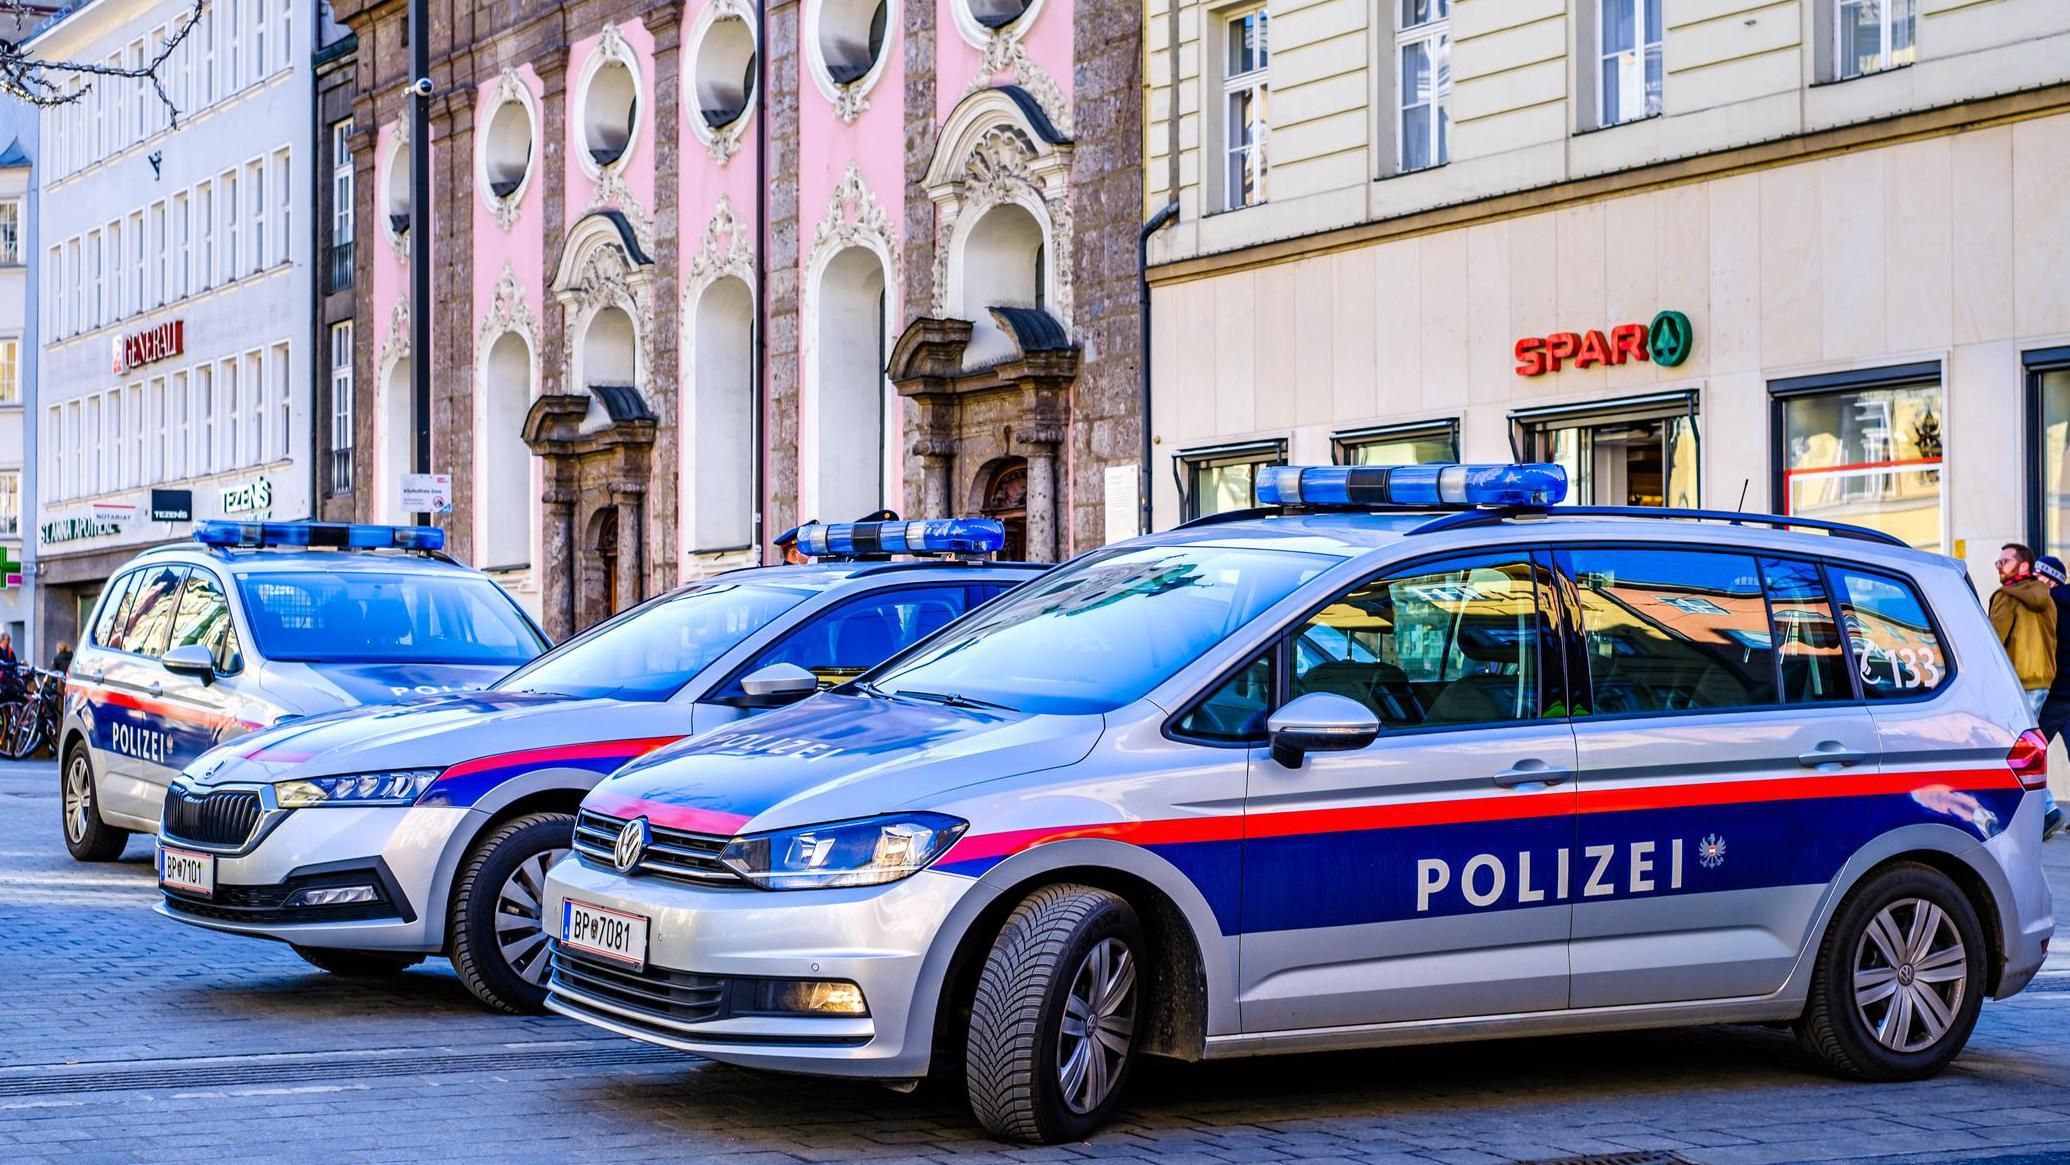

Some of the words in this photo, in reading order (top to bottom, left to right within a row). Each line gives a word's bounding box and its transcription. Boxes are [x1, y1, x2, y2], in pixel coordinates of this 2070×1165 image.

[124, 320, 183, 368] GENERALI
[1515, 323, 1650, 377] SPAR
[154, 510, 188, 519] TEZENIS
[219, 475, 272, 514] TEZENIS
[96, 513, 131, 521] NOTARIAT
[1884, 646, 1939, 689] 133
[112, 721, 164, 763] POLIZEI
[711, 733, 845, 763] POLIZEI
[167, 855, 177, 880] BP
[182, 858, 201, 885] 7101
[1416, 838, 1683, 911] POLIZEI
[574, 909, 590, 940] BP
[598, 915, 630, 953] 7081
